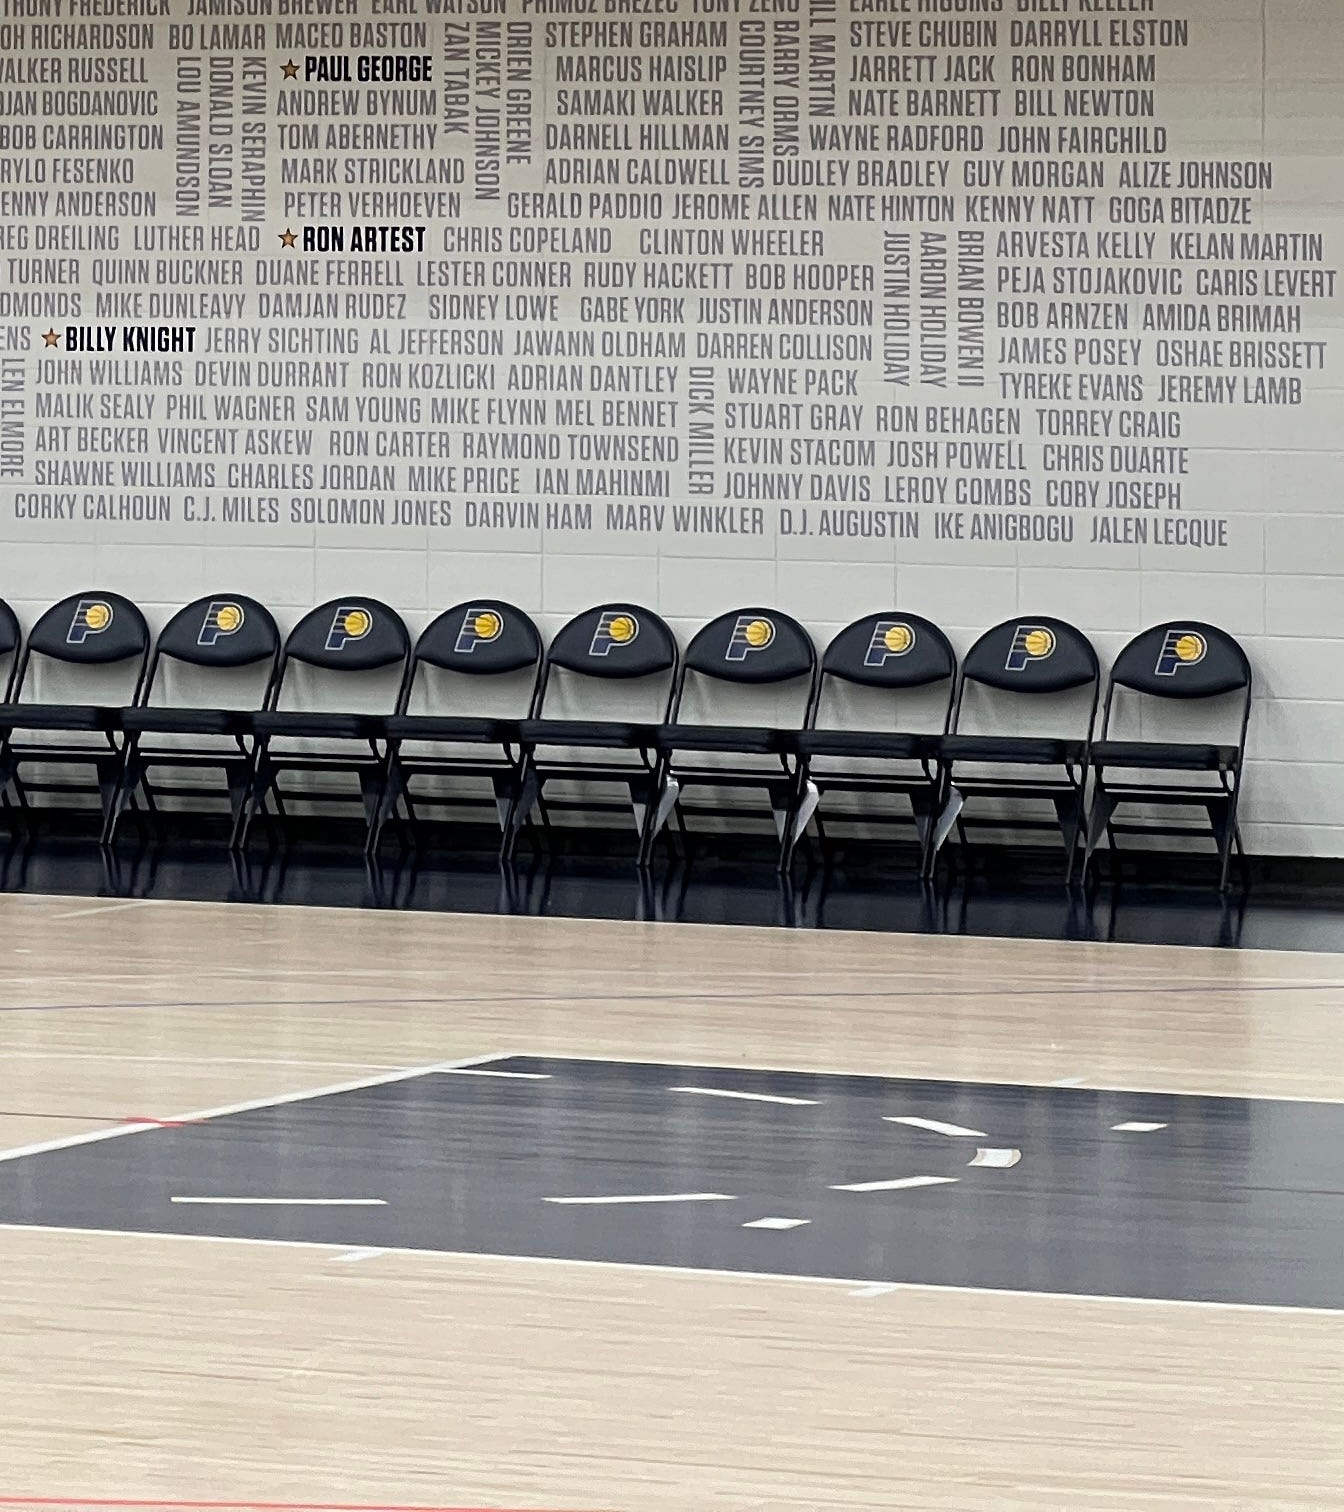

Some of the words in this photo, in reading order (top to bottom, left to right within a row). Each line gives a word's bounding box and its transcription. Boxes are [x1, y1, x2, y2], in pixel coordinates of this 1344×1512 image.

[545, 22, 633, 47] STEPHEN
[639, 21, 728, 47] GRAHAM
[305, 56, 352, 81] PAUL
[357, 56, 433, 81] GEORGE
[277, 124, 319, 149] TOM
[325, 124, 438, 149] ABERNETHY
[1118, 162, 1171, 188] ALIZE
[1176, 162, 1272, 189] JOHNSON
[303, 226, 344, 252] RON
[350, 227, 428, 252] ARTEST
[1170, 233, 1235, 259] KELAN
[1240, 233, 1323, 261] MARTIN
[997, 266, 1046, 293] PEJA
[1052, 267, 1183, 295] STOJAKOVIC
[1196, 269, 1258, 296] CARIS
[1264, 270, 1337, 297] LEVERT
[65, 327, 116, 351] BILLY
[122, 327, 198, 352] KNIGHT
[696, 333, 773, 359] DARREN
[779, 334, 873, 360] COLLISON
[1156, 340, 1224, 367] OSHAE
[1229, 341, 1326, 368] BRISSETT
[305, 396, 349, 421] SAM
[355, 397, 421, 423] YOUNG
